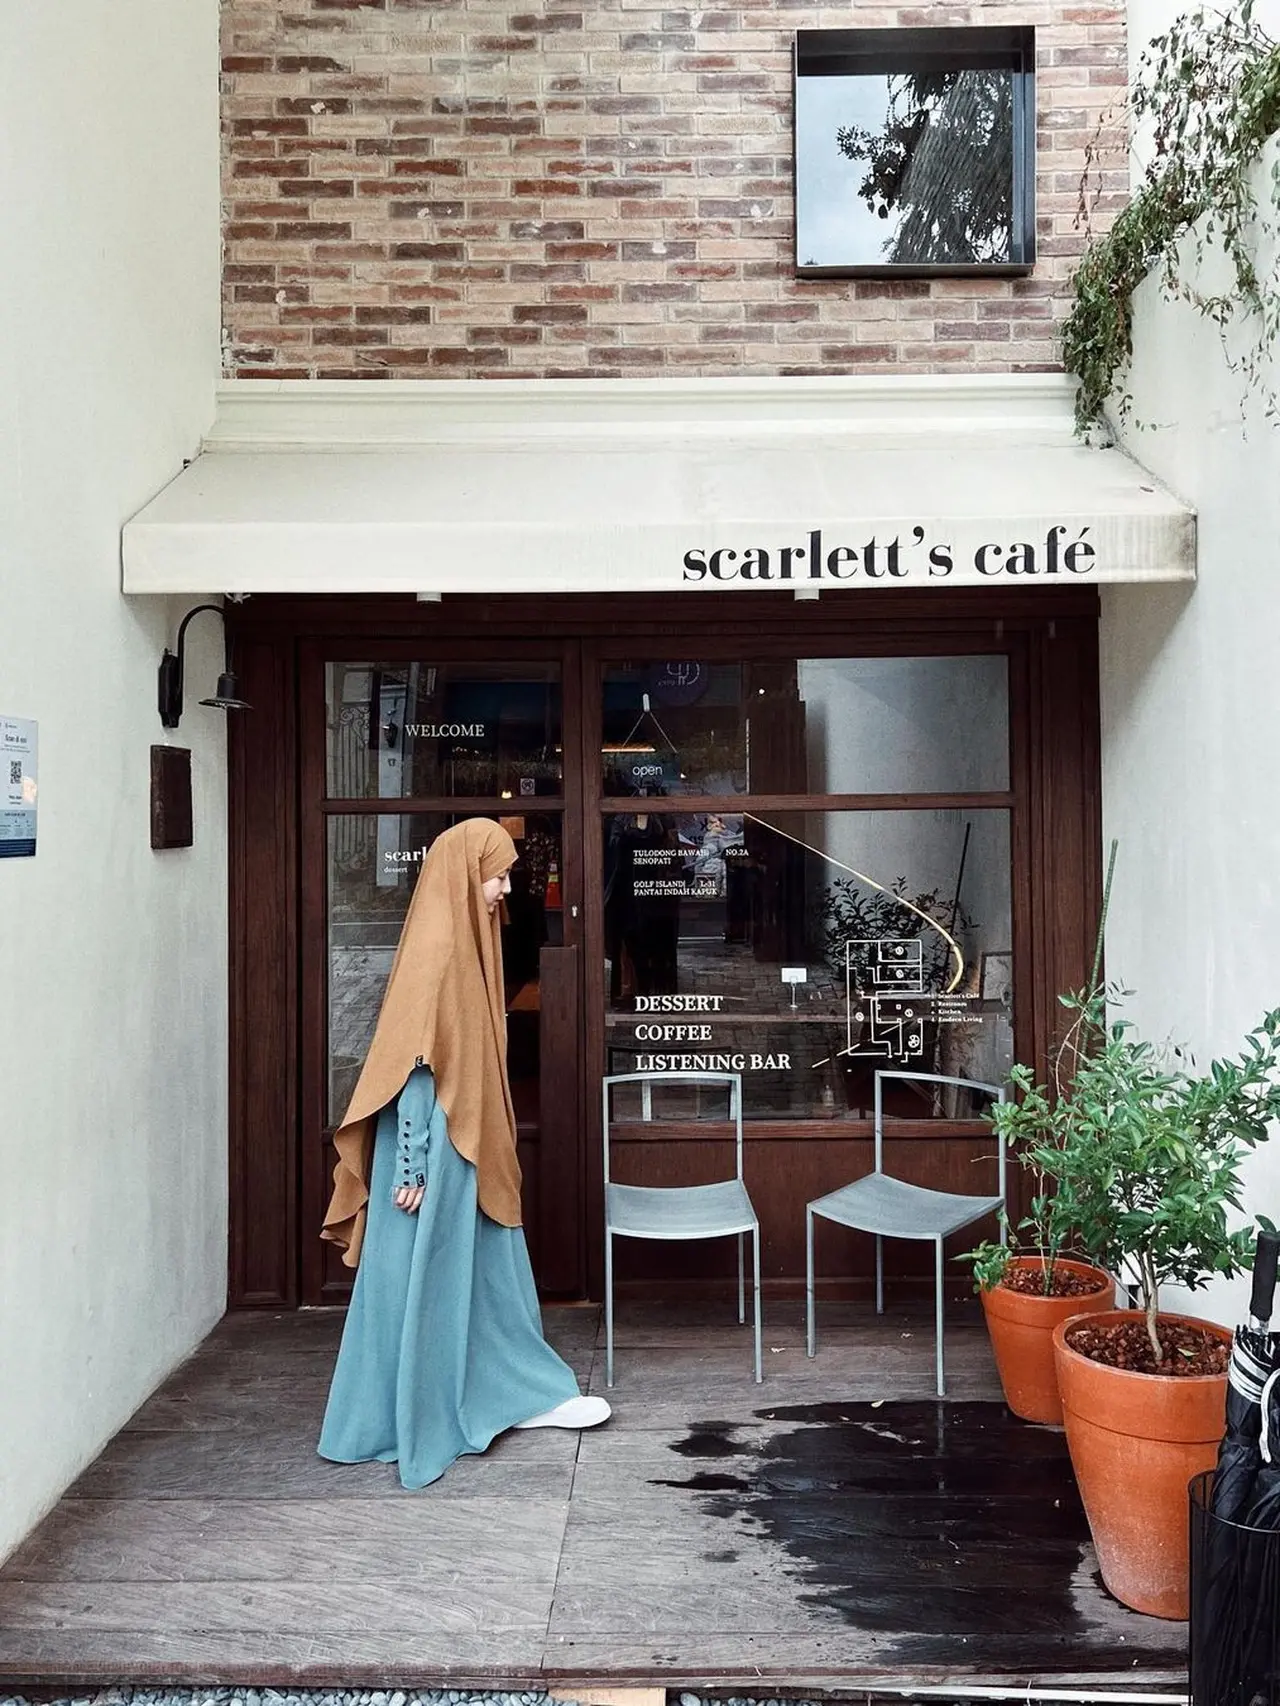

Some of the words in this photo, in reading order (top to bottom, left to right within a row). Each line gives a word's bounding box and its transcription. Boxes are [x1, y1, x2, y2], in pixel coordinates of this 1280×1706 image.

[682, 526, 954, 581] scarlett's
[973, 525, 1096, 576] café
[404, 723, 485, 738] WELCOME
[632, 766, 663, 778] open
[383, 846, 427, 862] scarl
[633, 849, 677, 857] TULODONG
[633, 857, 672, 865] SENOPATI
[633, 880, 654, 888] GOLF
[633, 888, 662, 896] PANTAI
[664, 888, 690, 896] INDAH
[634, 995, 723, 1012] DESSERT
[634, 1024, 712, 1041] COFFEE
[635, 1054, 746, 1071] LISTENING
[749, 1053, 792, 1070] BAR
